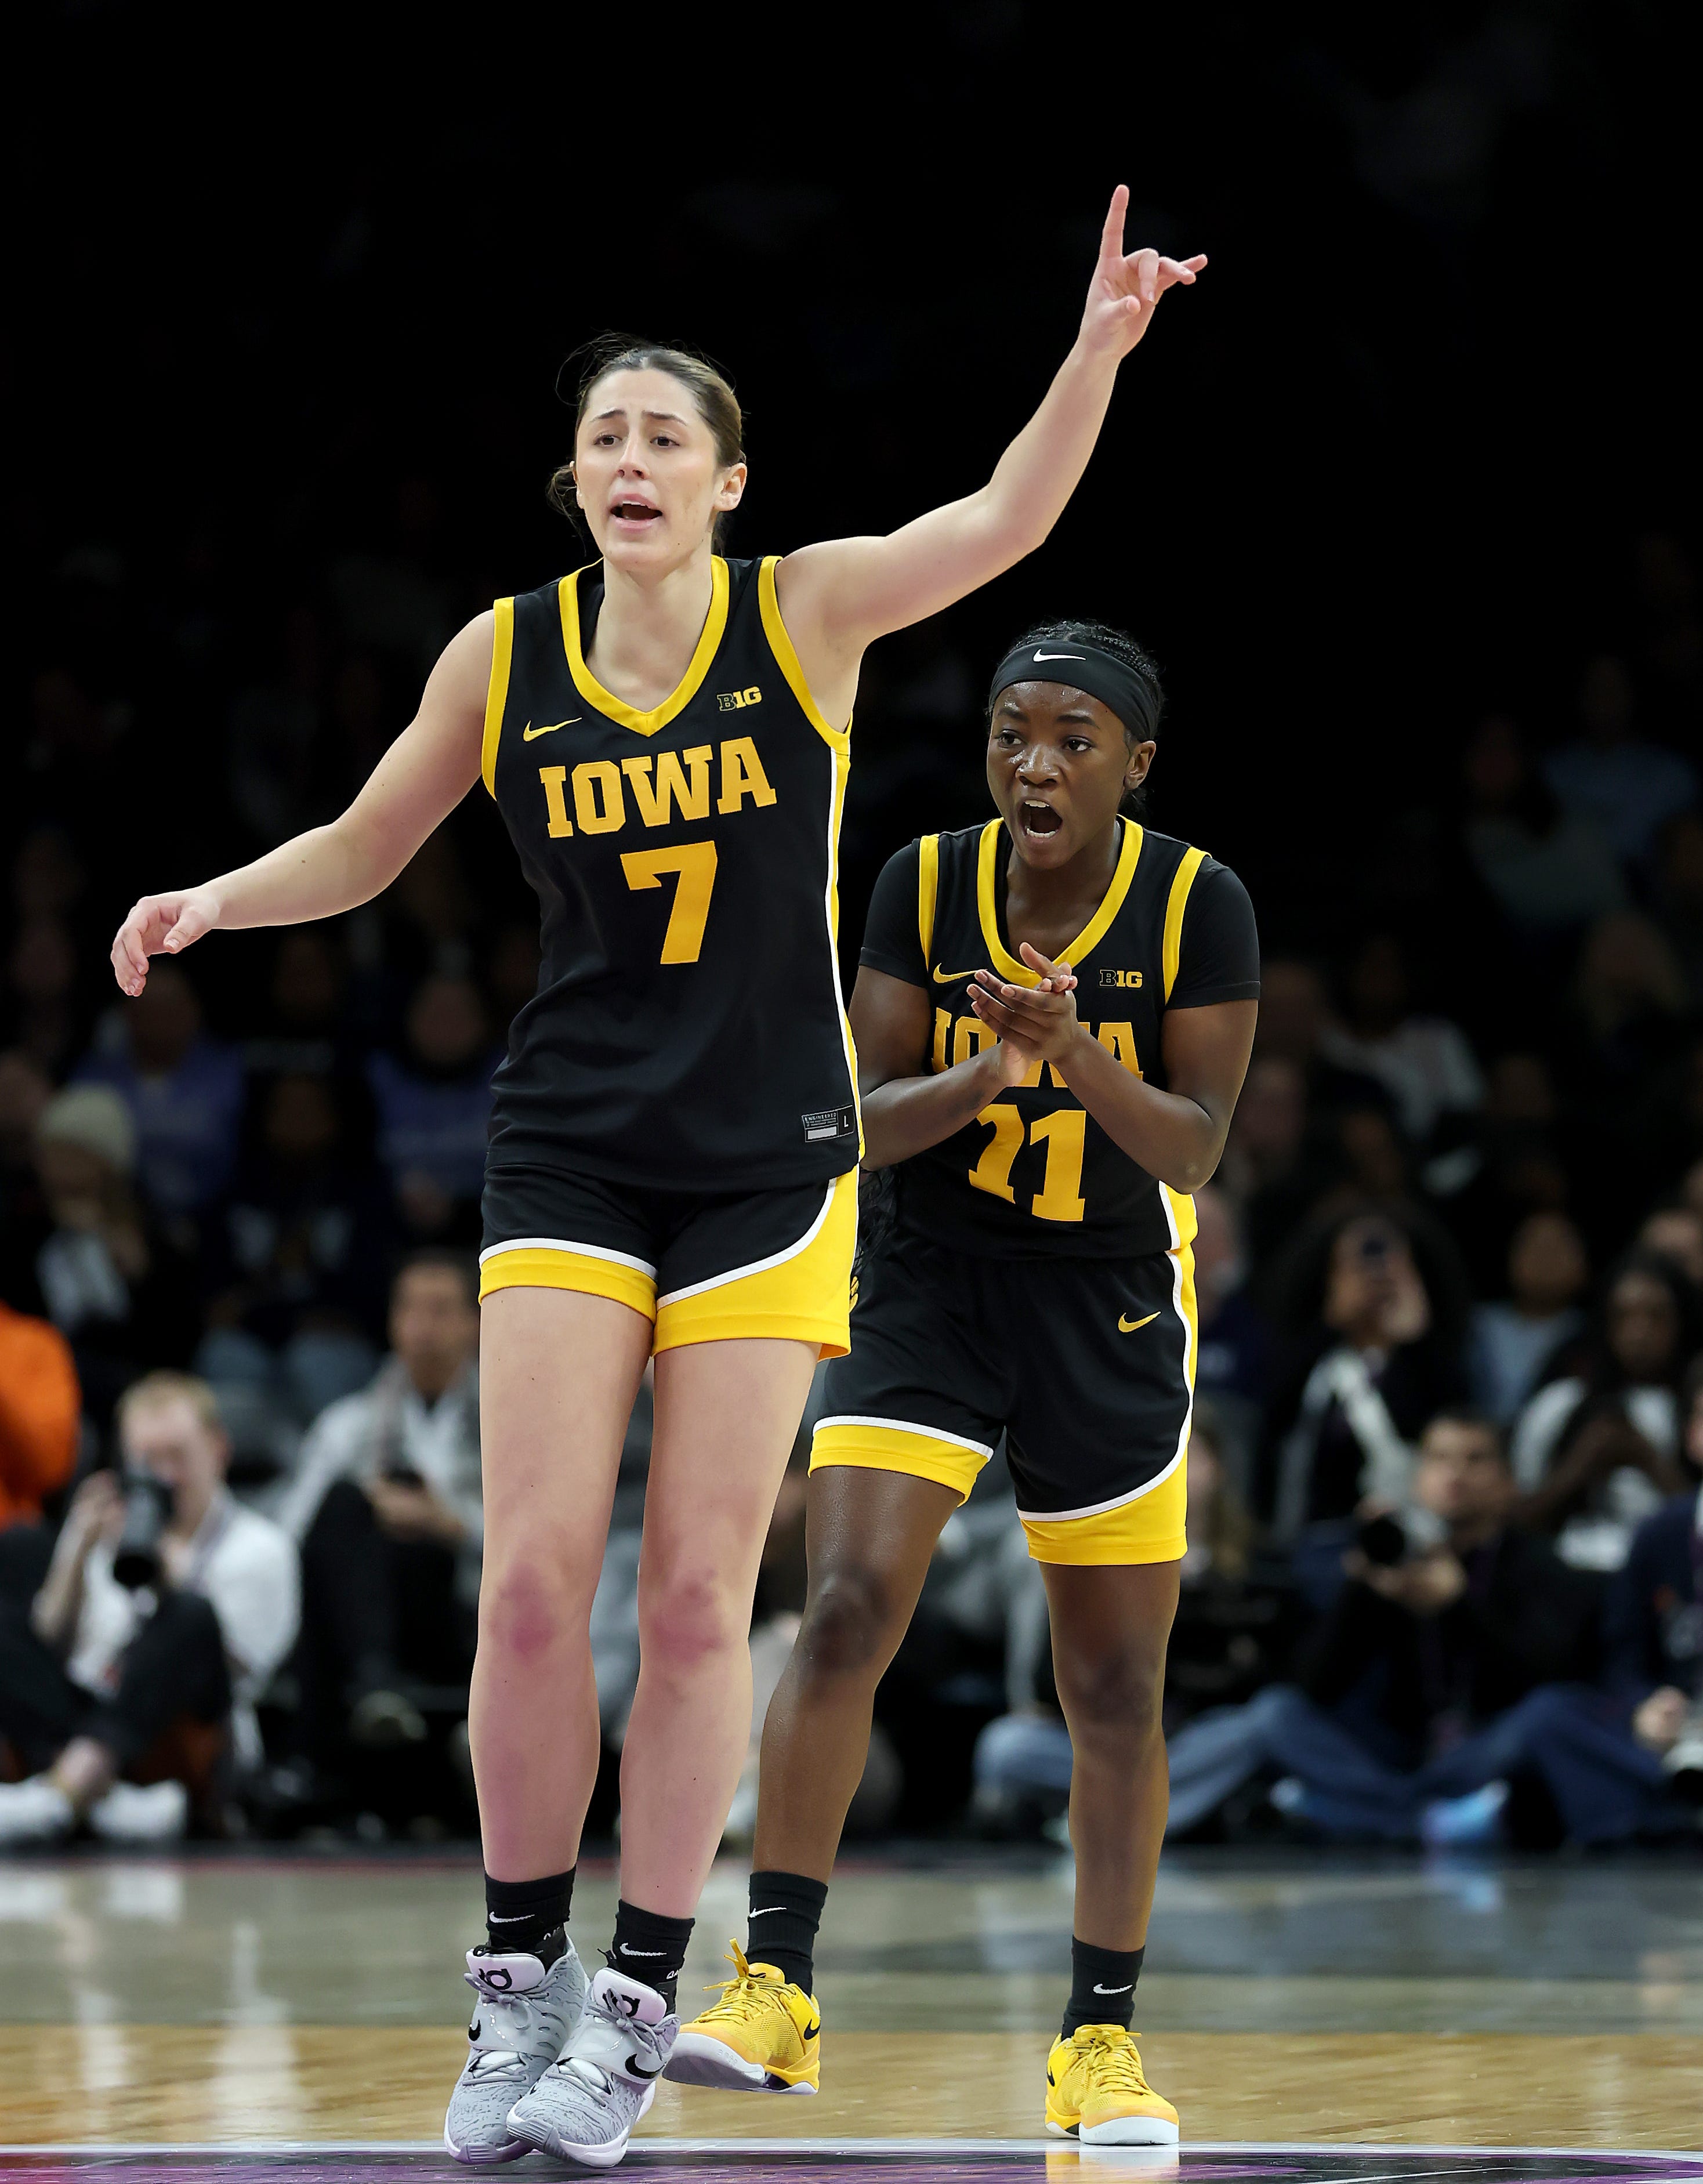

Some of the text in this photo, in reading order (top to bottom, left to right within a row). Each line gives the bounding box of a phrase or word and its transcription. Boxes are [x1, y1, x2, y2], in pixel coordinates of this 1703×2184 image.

[539, 737, 777, 838] IOWA
[620, 840, 718, 965] 7
[844, 1115, 849, 1127] L
[969, 1104, 1086, 1221] 21
